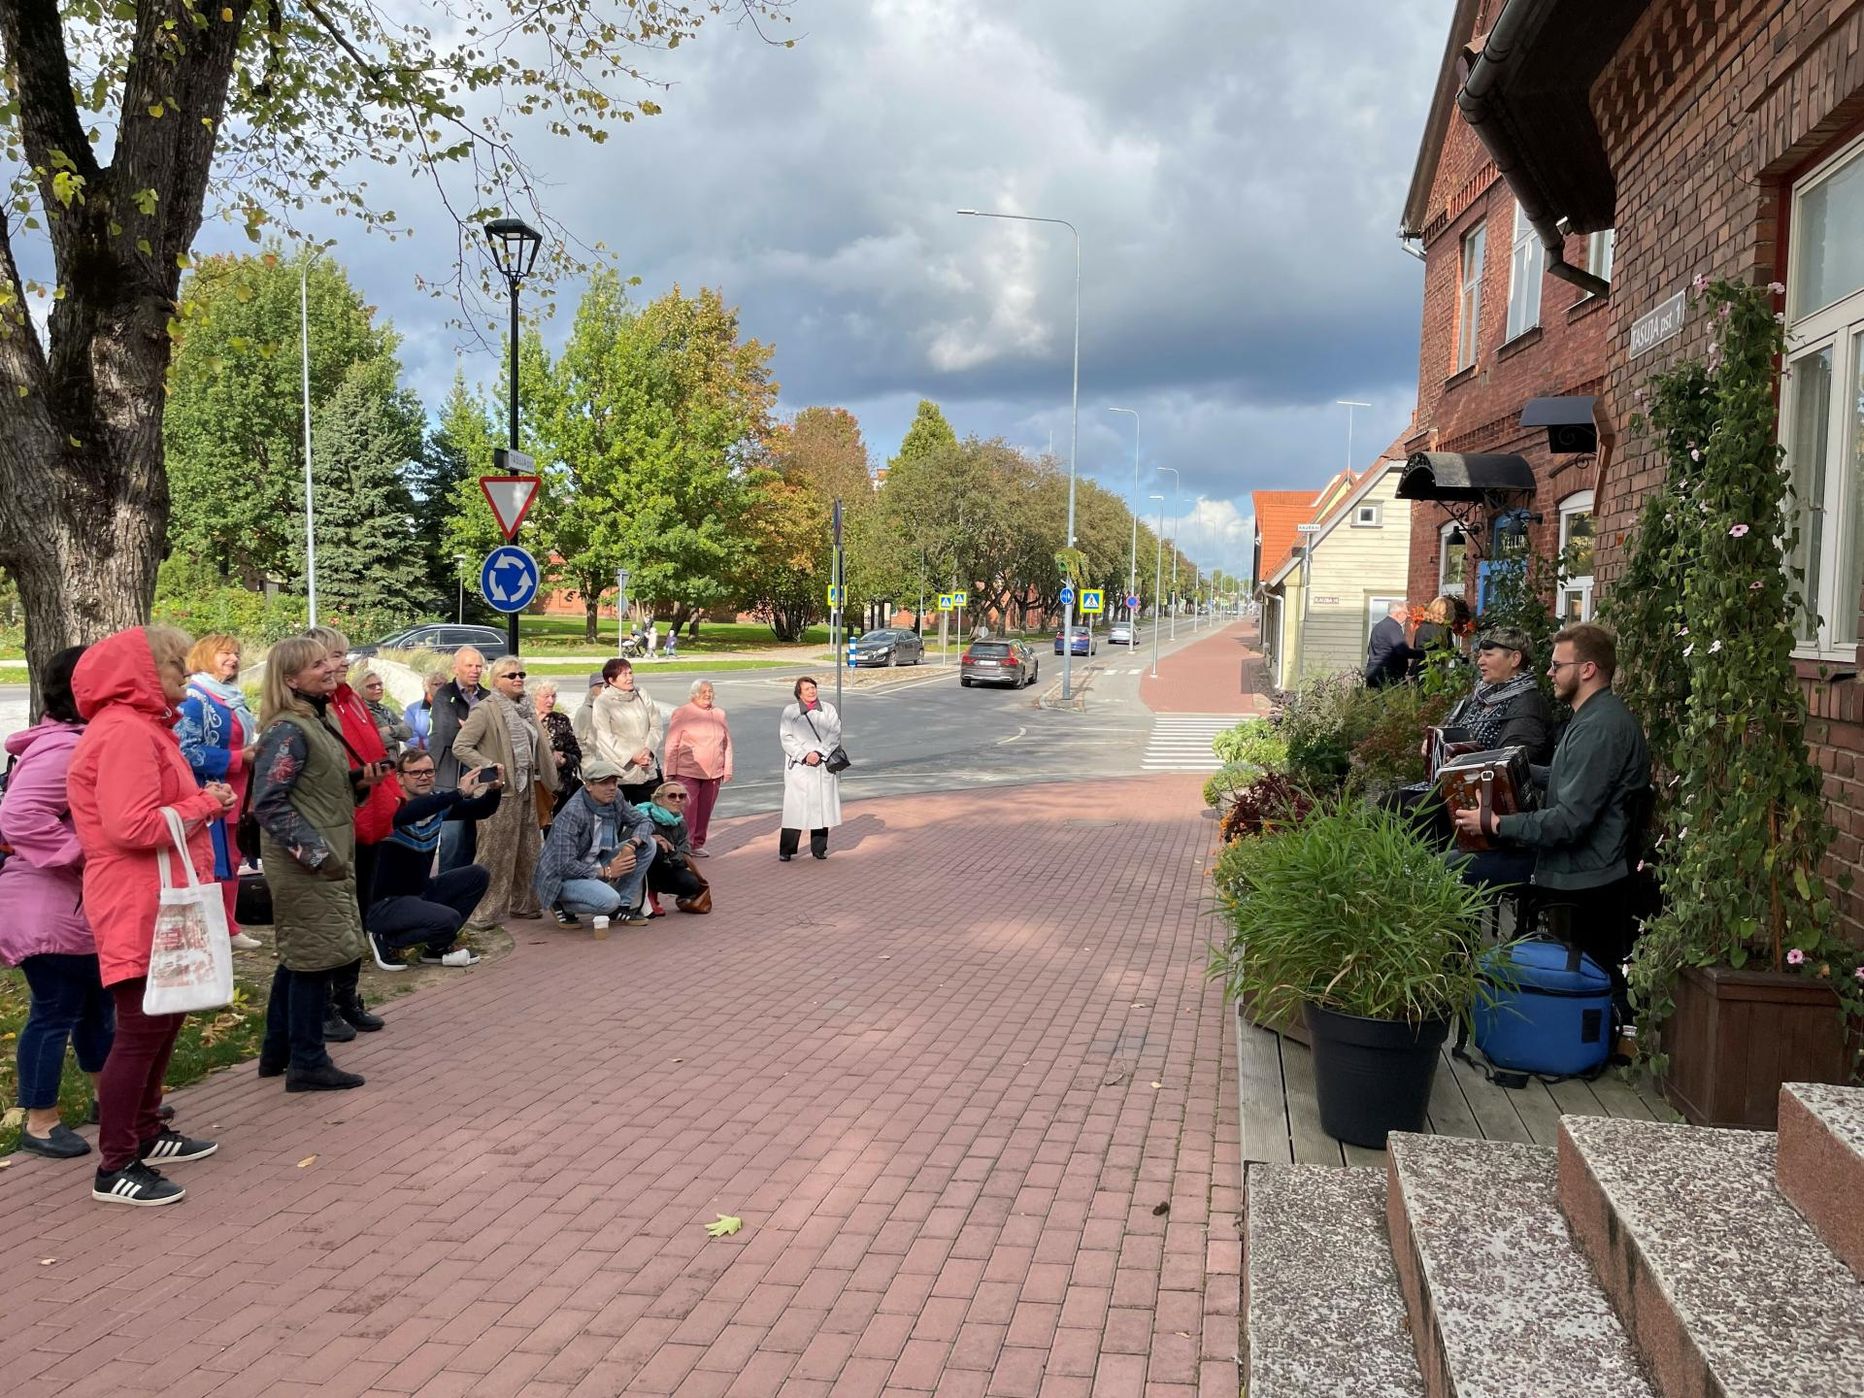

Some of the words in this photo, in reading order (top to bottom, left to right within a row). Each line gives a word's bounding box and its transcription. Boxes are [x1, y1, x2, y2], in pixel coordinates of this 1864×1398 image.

[1632, 316, 1659, 351] TASUJA
[1660, 310, 1673, 338] pst
[1675, 301, 1681, 324] 1
